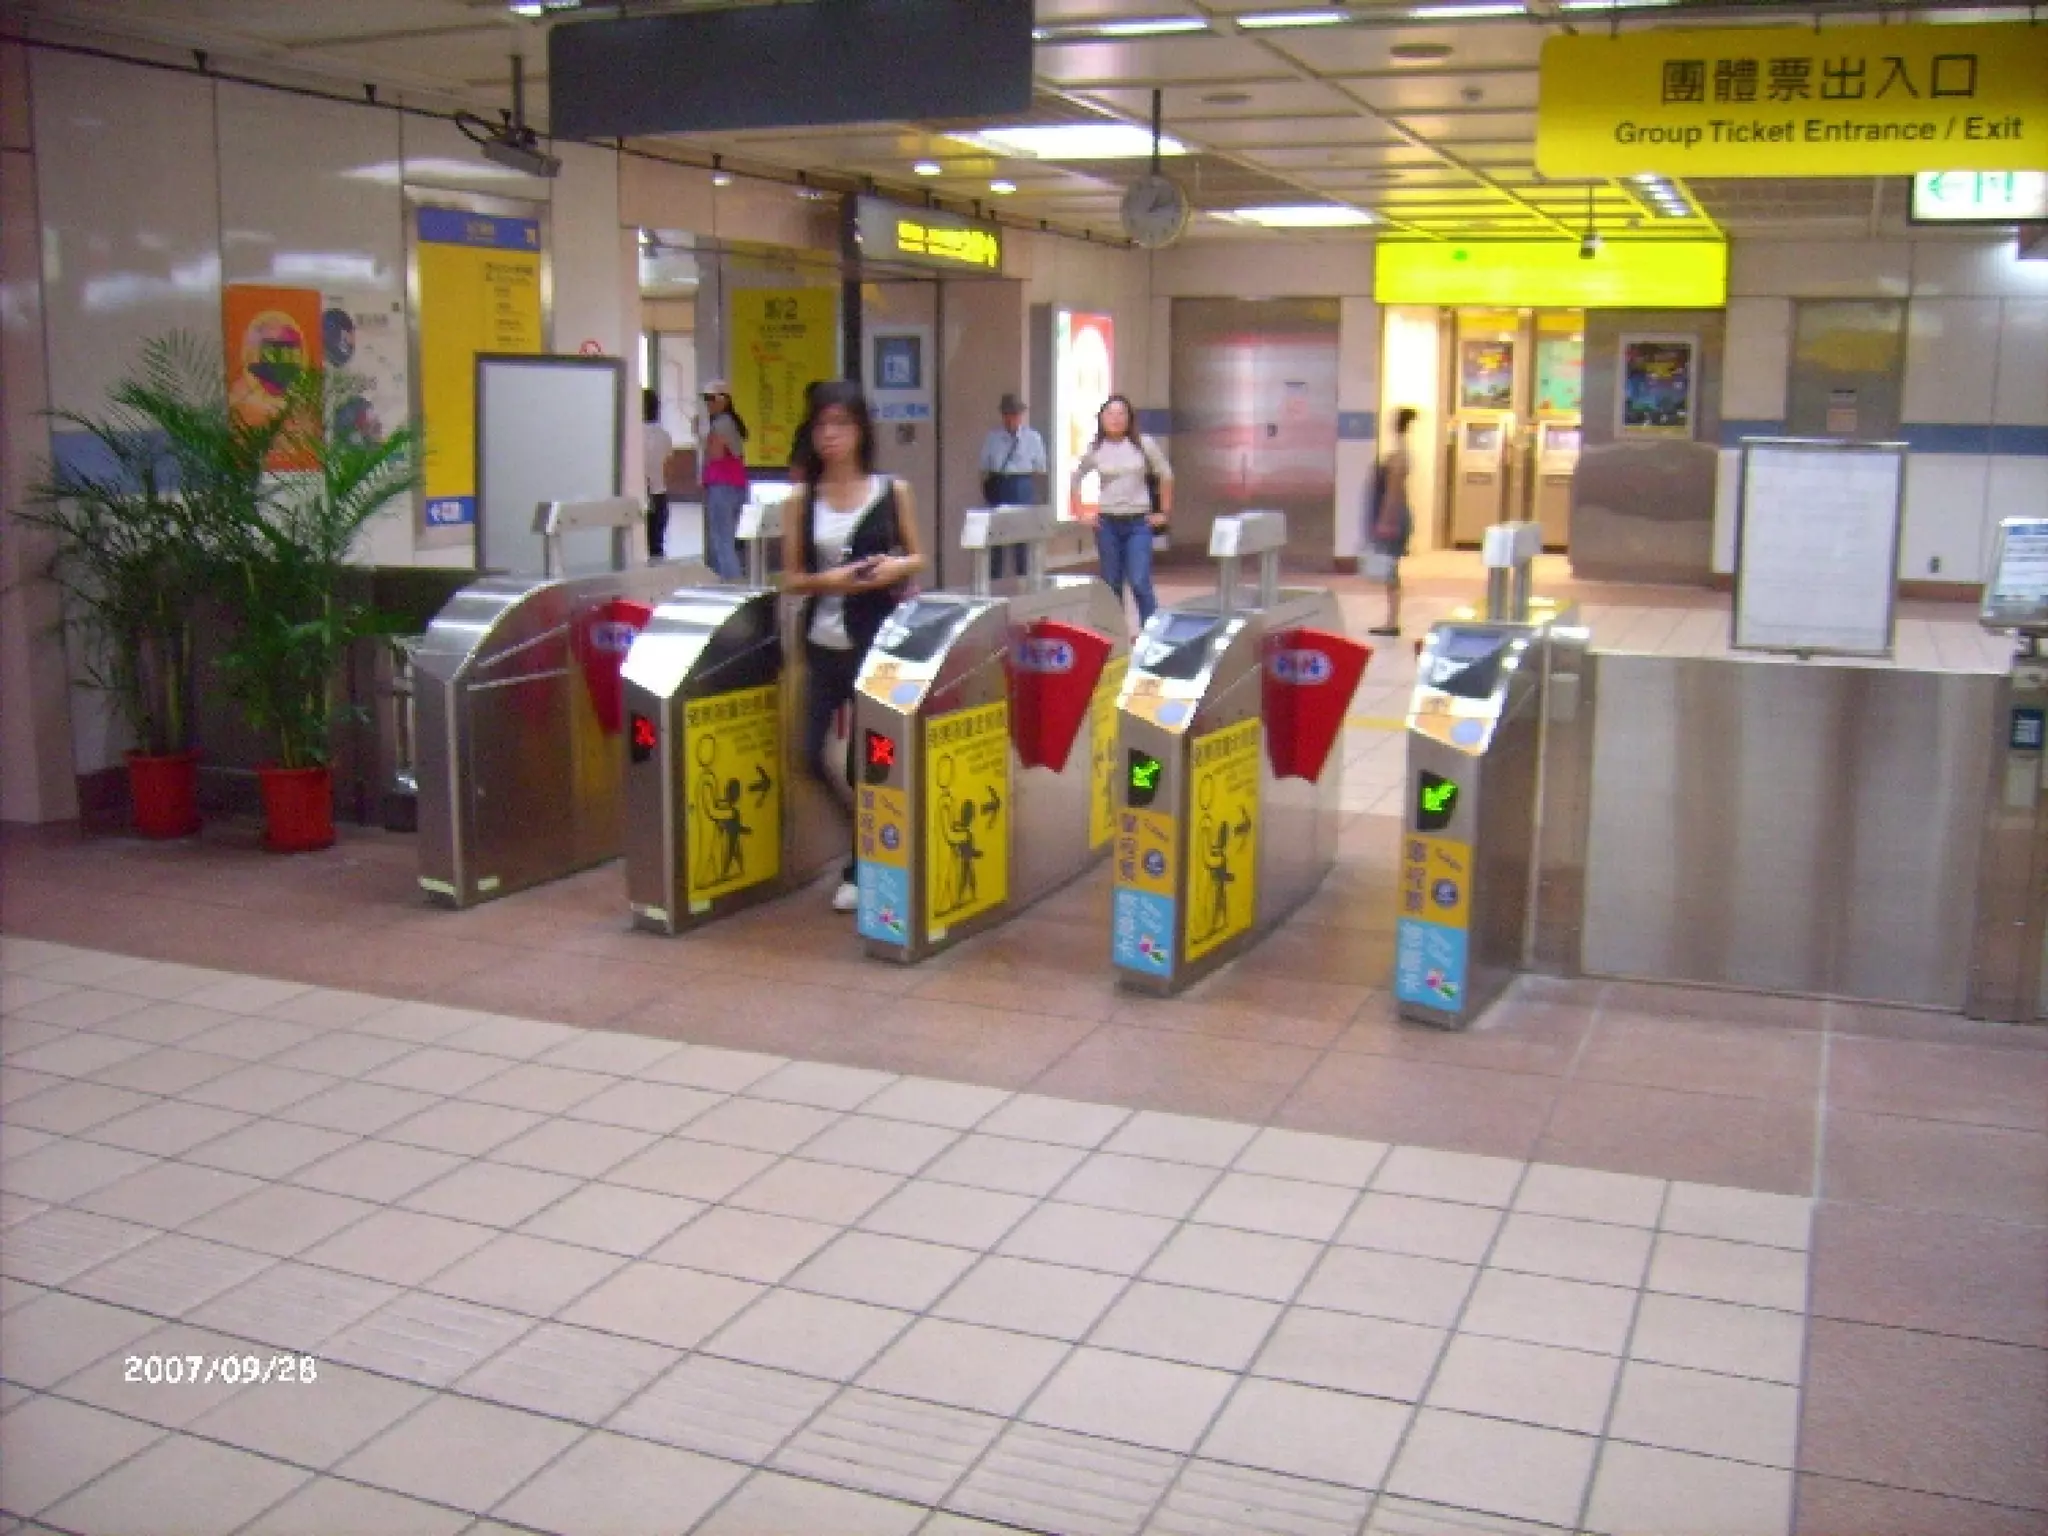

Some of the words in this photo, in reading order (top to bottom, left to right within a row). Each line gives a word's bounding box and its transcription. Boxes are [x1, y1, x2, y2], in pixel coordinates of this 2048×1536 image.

[1661, 53, 1979, 105] 團體票出入口
[1614, 120, 1703, 149] Group
[1708, 119, 1795, 143] Ticket
[1804, 117, 1937, 142] Entrance
[1943, 117, 1956, 141] /
[1964, 115, 2024, 140] Exit
